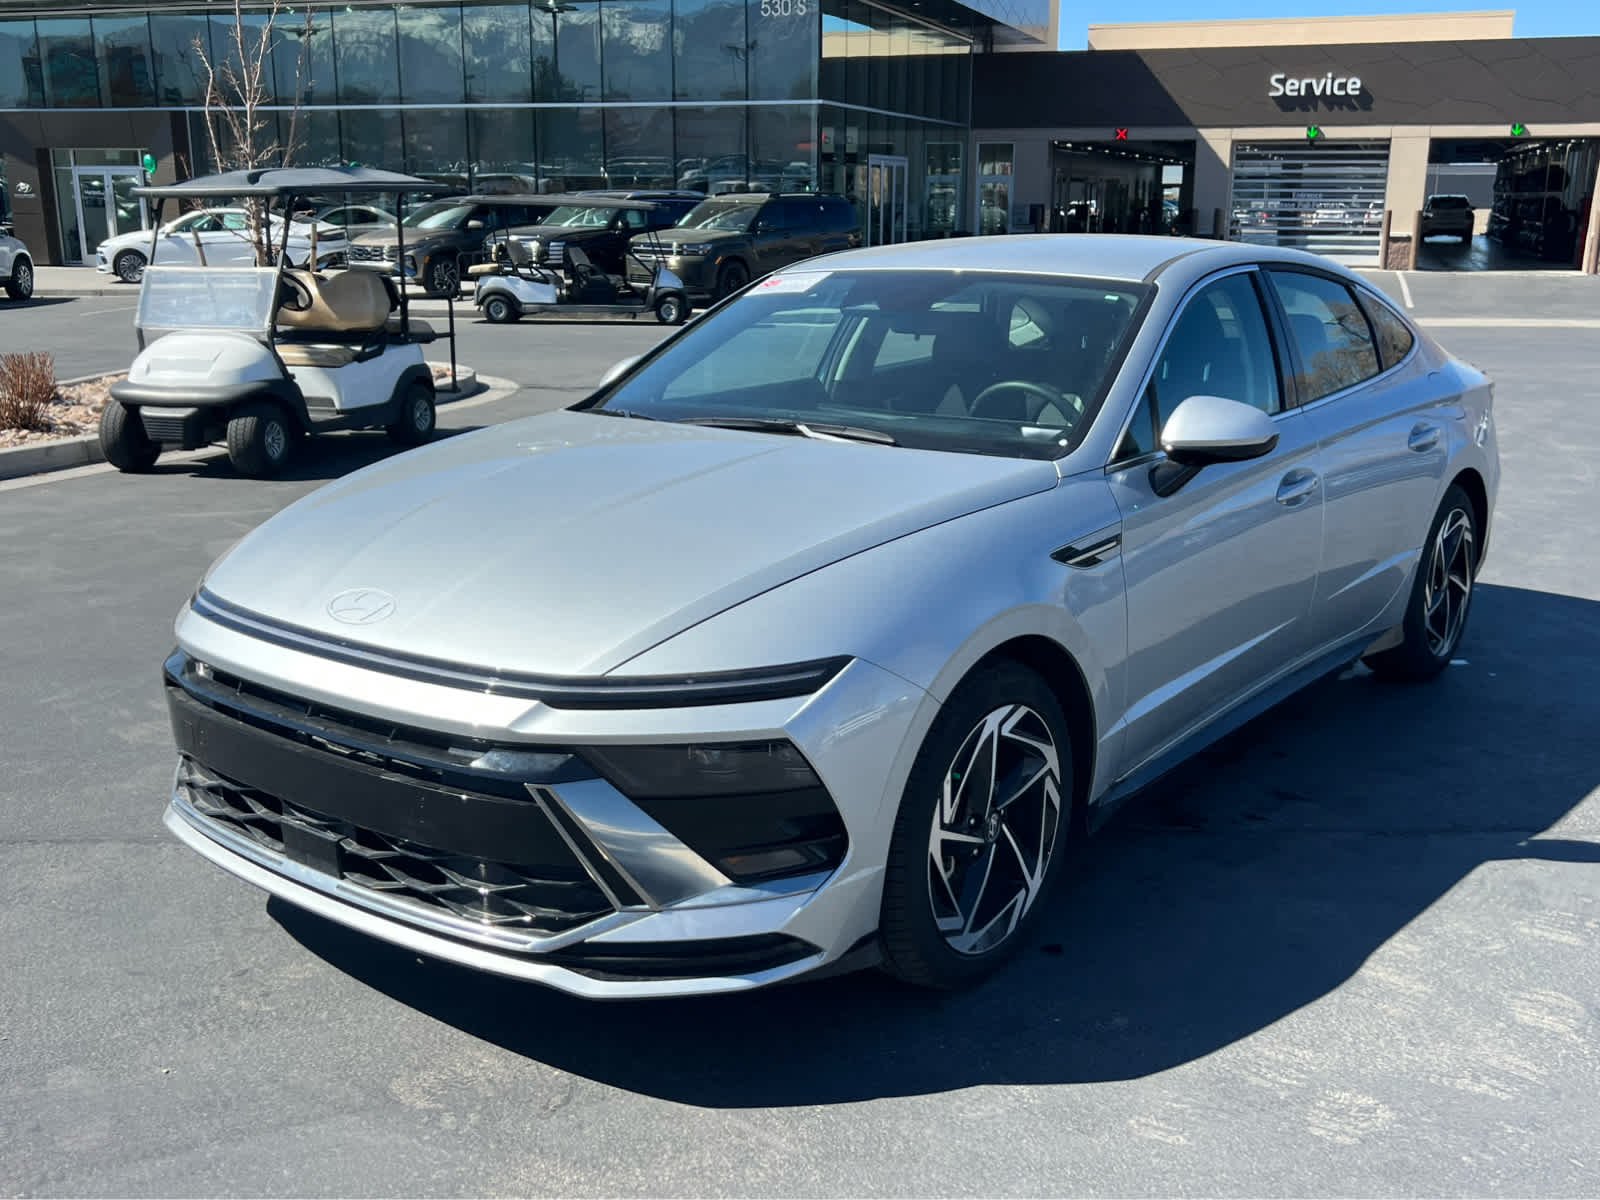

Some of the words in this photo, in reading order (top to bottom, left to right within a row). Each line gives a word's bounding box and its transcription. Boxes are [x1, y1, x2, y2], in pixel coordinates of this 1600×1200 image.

[760, 0, 791, 16] 530
[796, 0, 807, 15] S
[1268, 72, 1361, 96] Service
